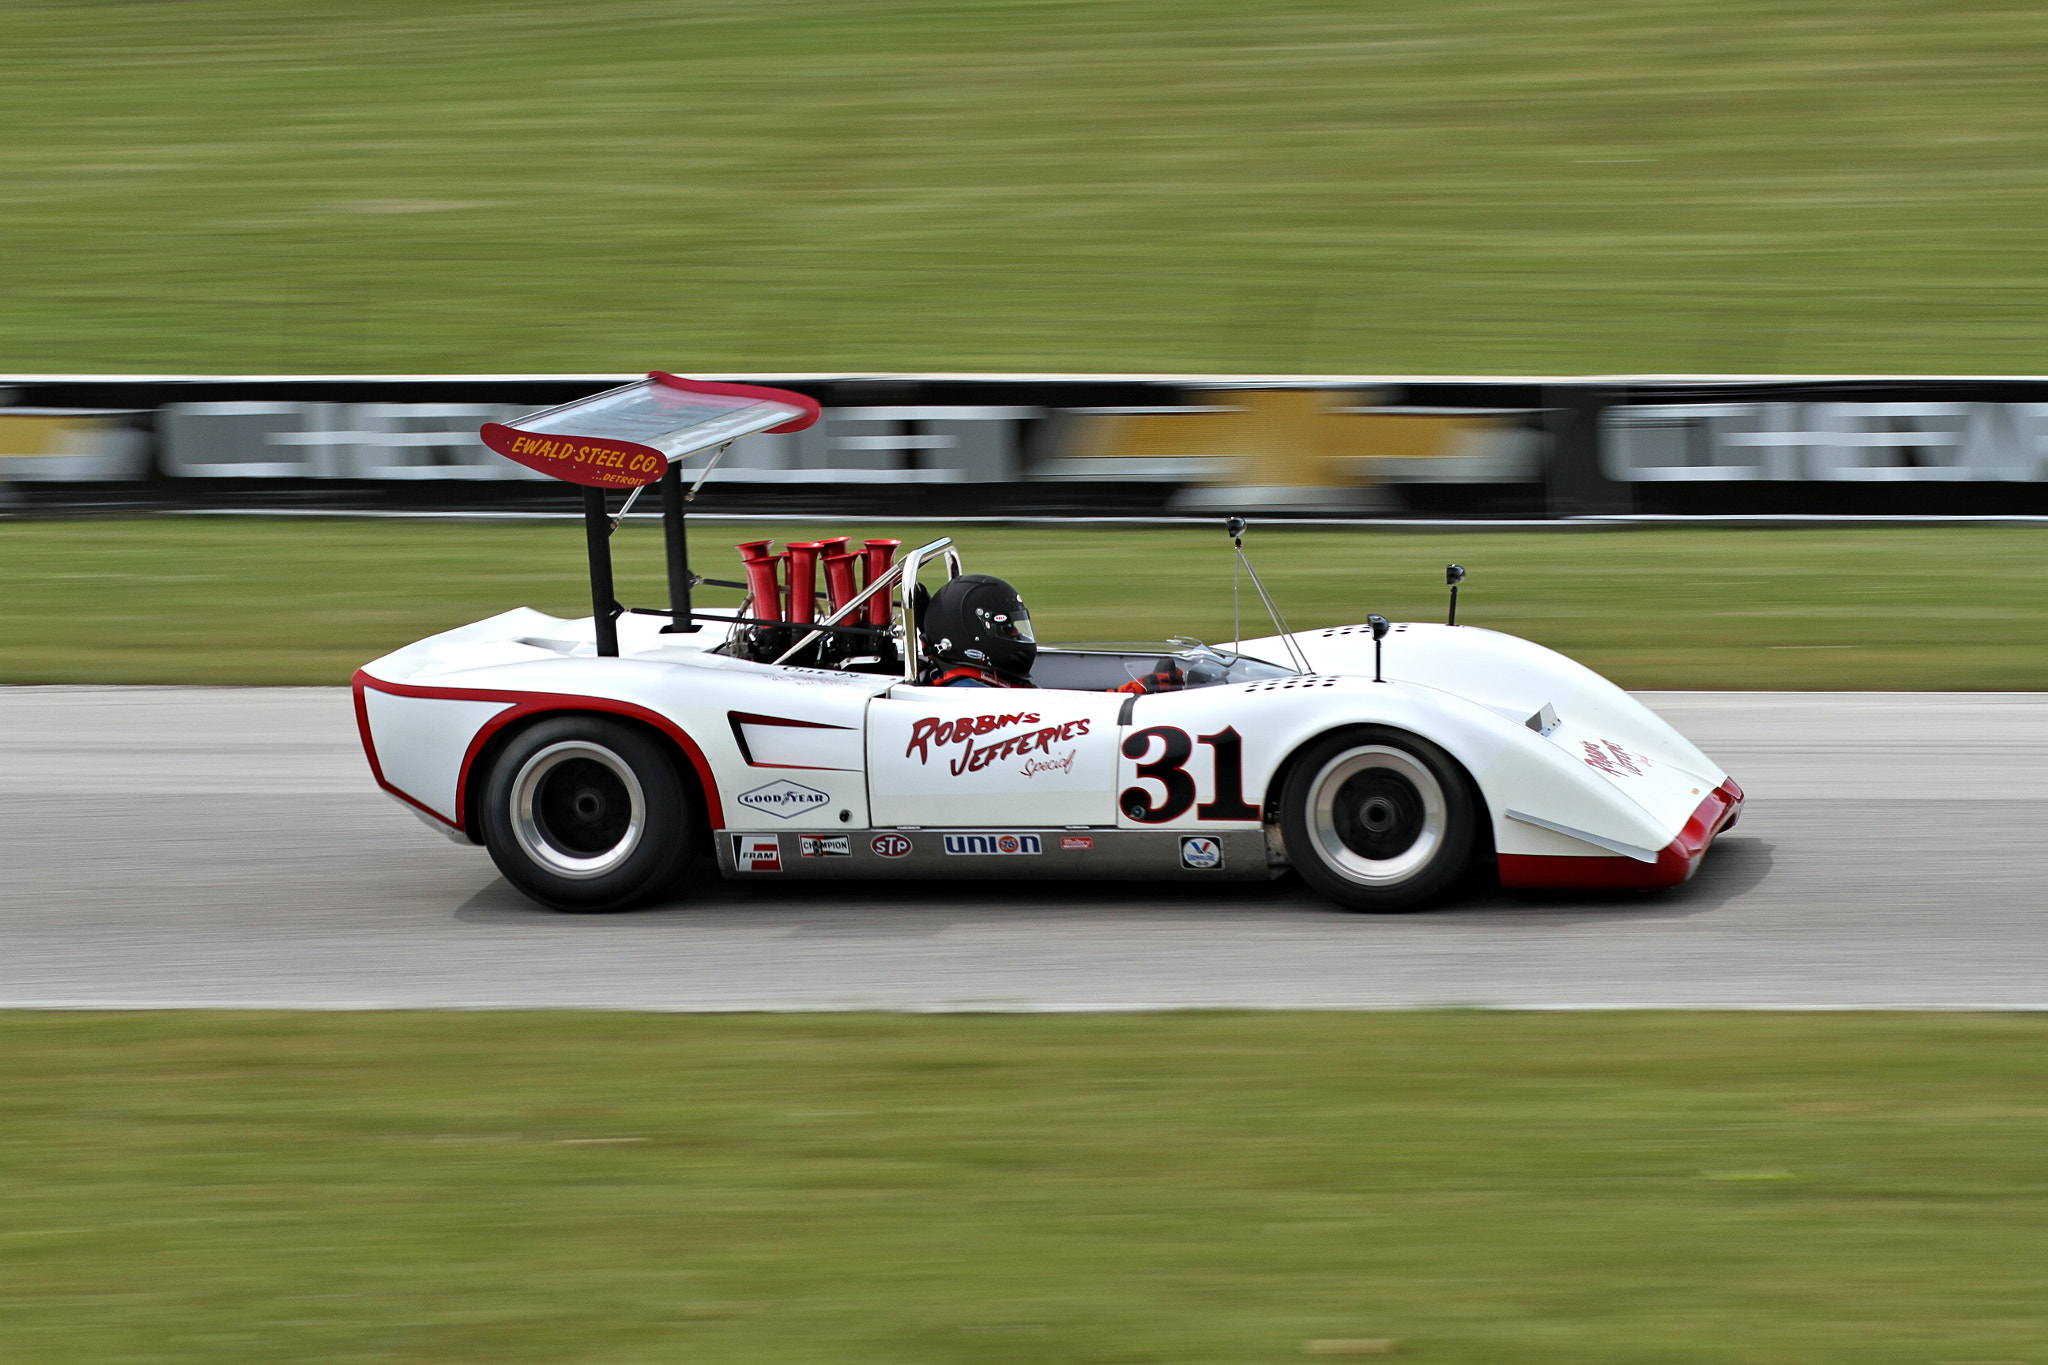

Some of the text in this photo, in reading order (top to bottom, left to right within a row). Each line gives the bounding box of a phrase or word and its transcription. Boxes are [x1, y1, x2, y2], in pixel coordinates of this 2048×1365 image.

[511, 436, 660, 475] EWALD STEEL CO.
[906, 712, 1040, 765] ROBBINS
[950, 718, 1090, 776] JEFFERIES
[1020, 749, 1075, 778] Special
[1119, 724, 1262, 824] 31
[803, 841, 847, 850] CHMPION
[875, 837, 907, 855] STP
